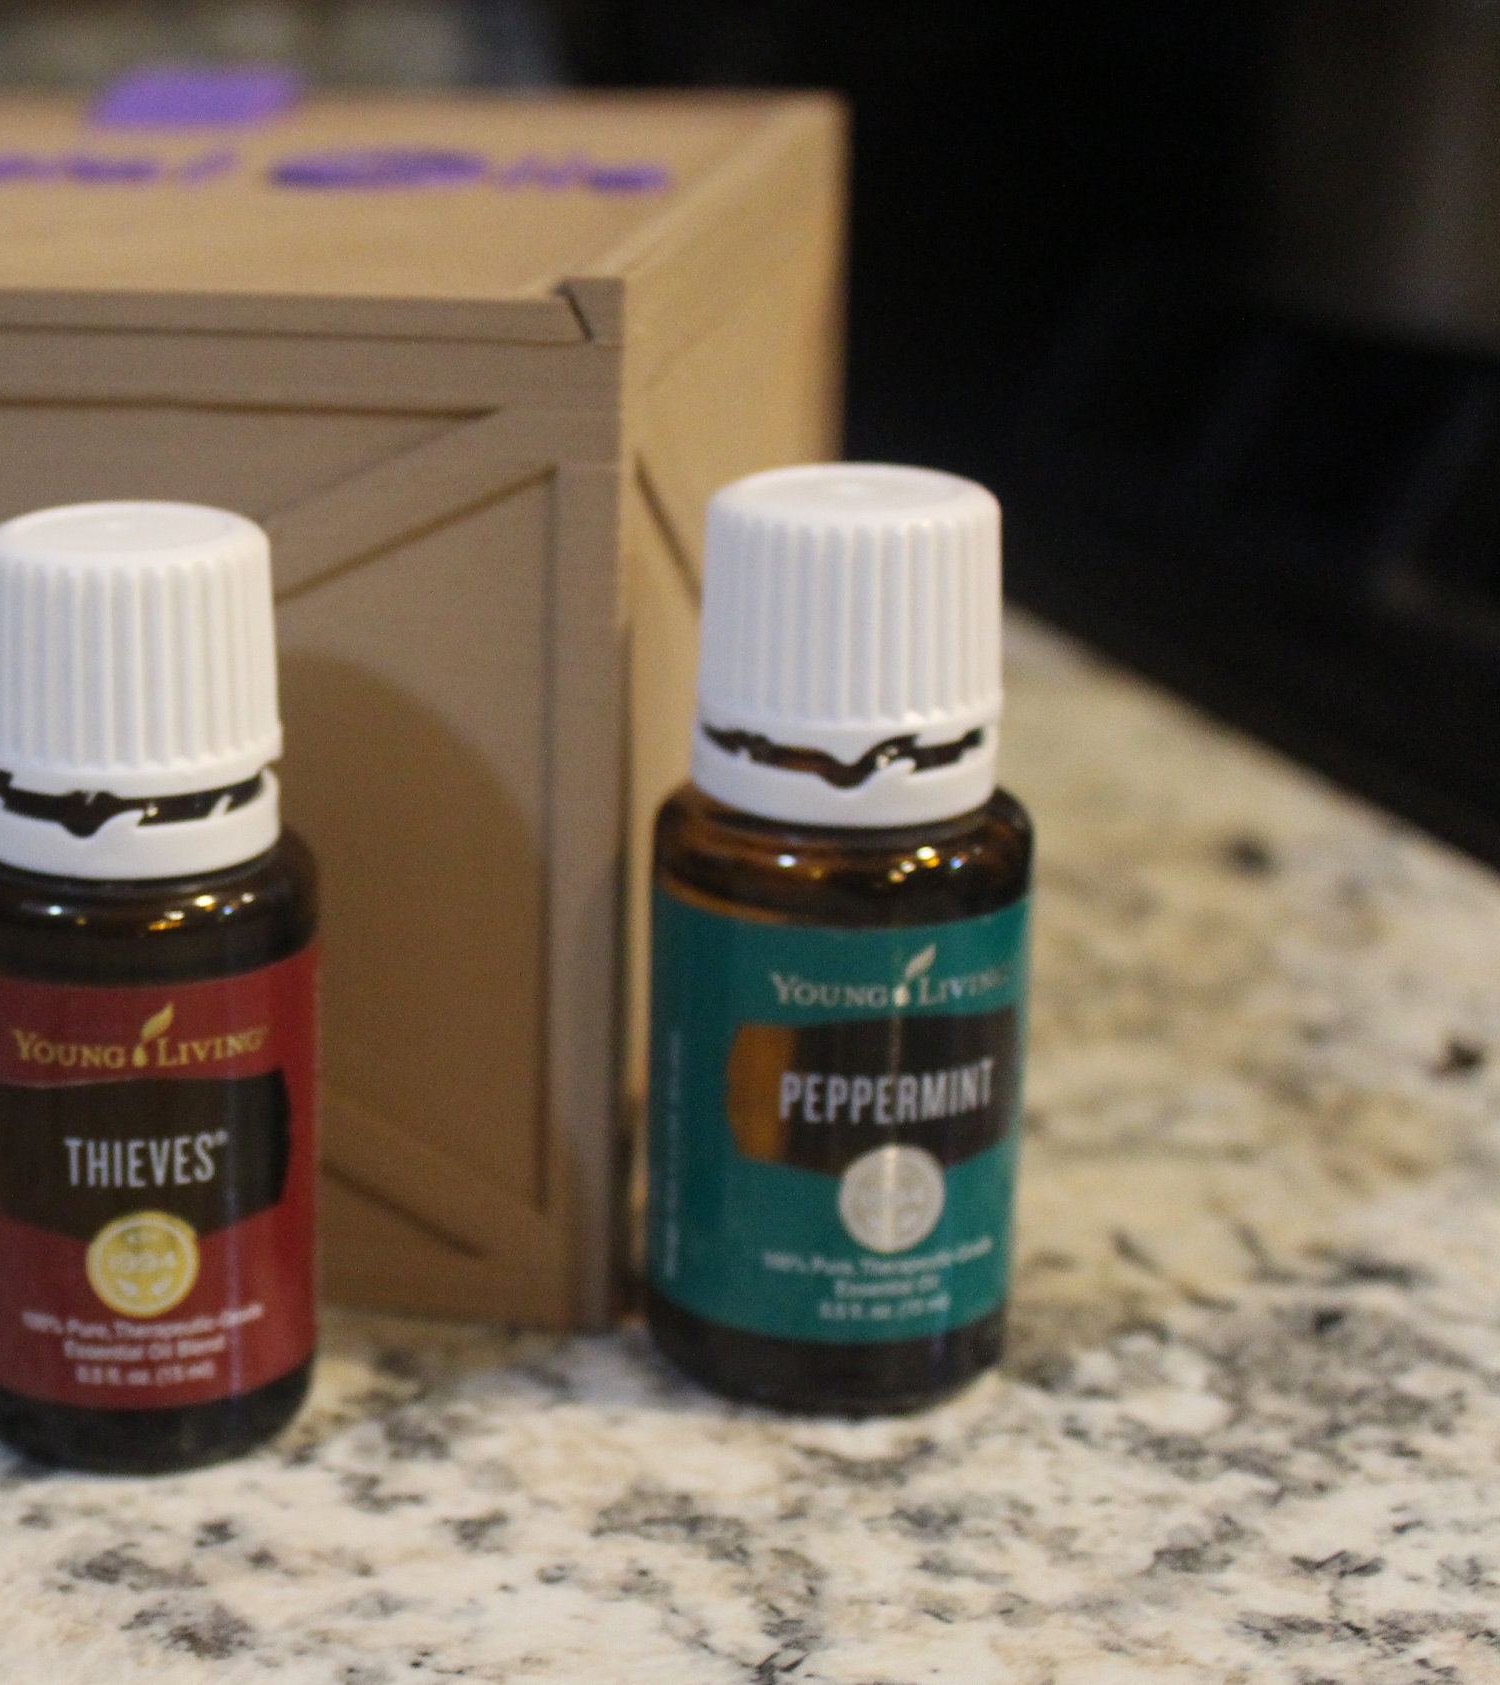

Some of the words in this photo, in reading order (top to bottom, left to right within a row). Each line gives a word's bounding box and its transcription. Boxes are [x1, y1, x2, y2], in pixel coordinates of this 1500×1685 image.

[770, 970, 888, 1009] YOUNG
[12, 1027, 127, 1069] YOUNG
[156, 1026, 269, 1067] LIVING
[778, 1056, 994, 1125] PEPPERMINT
